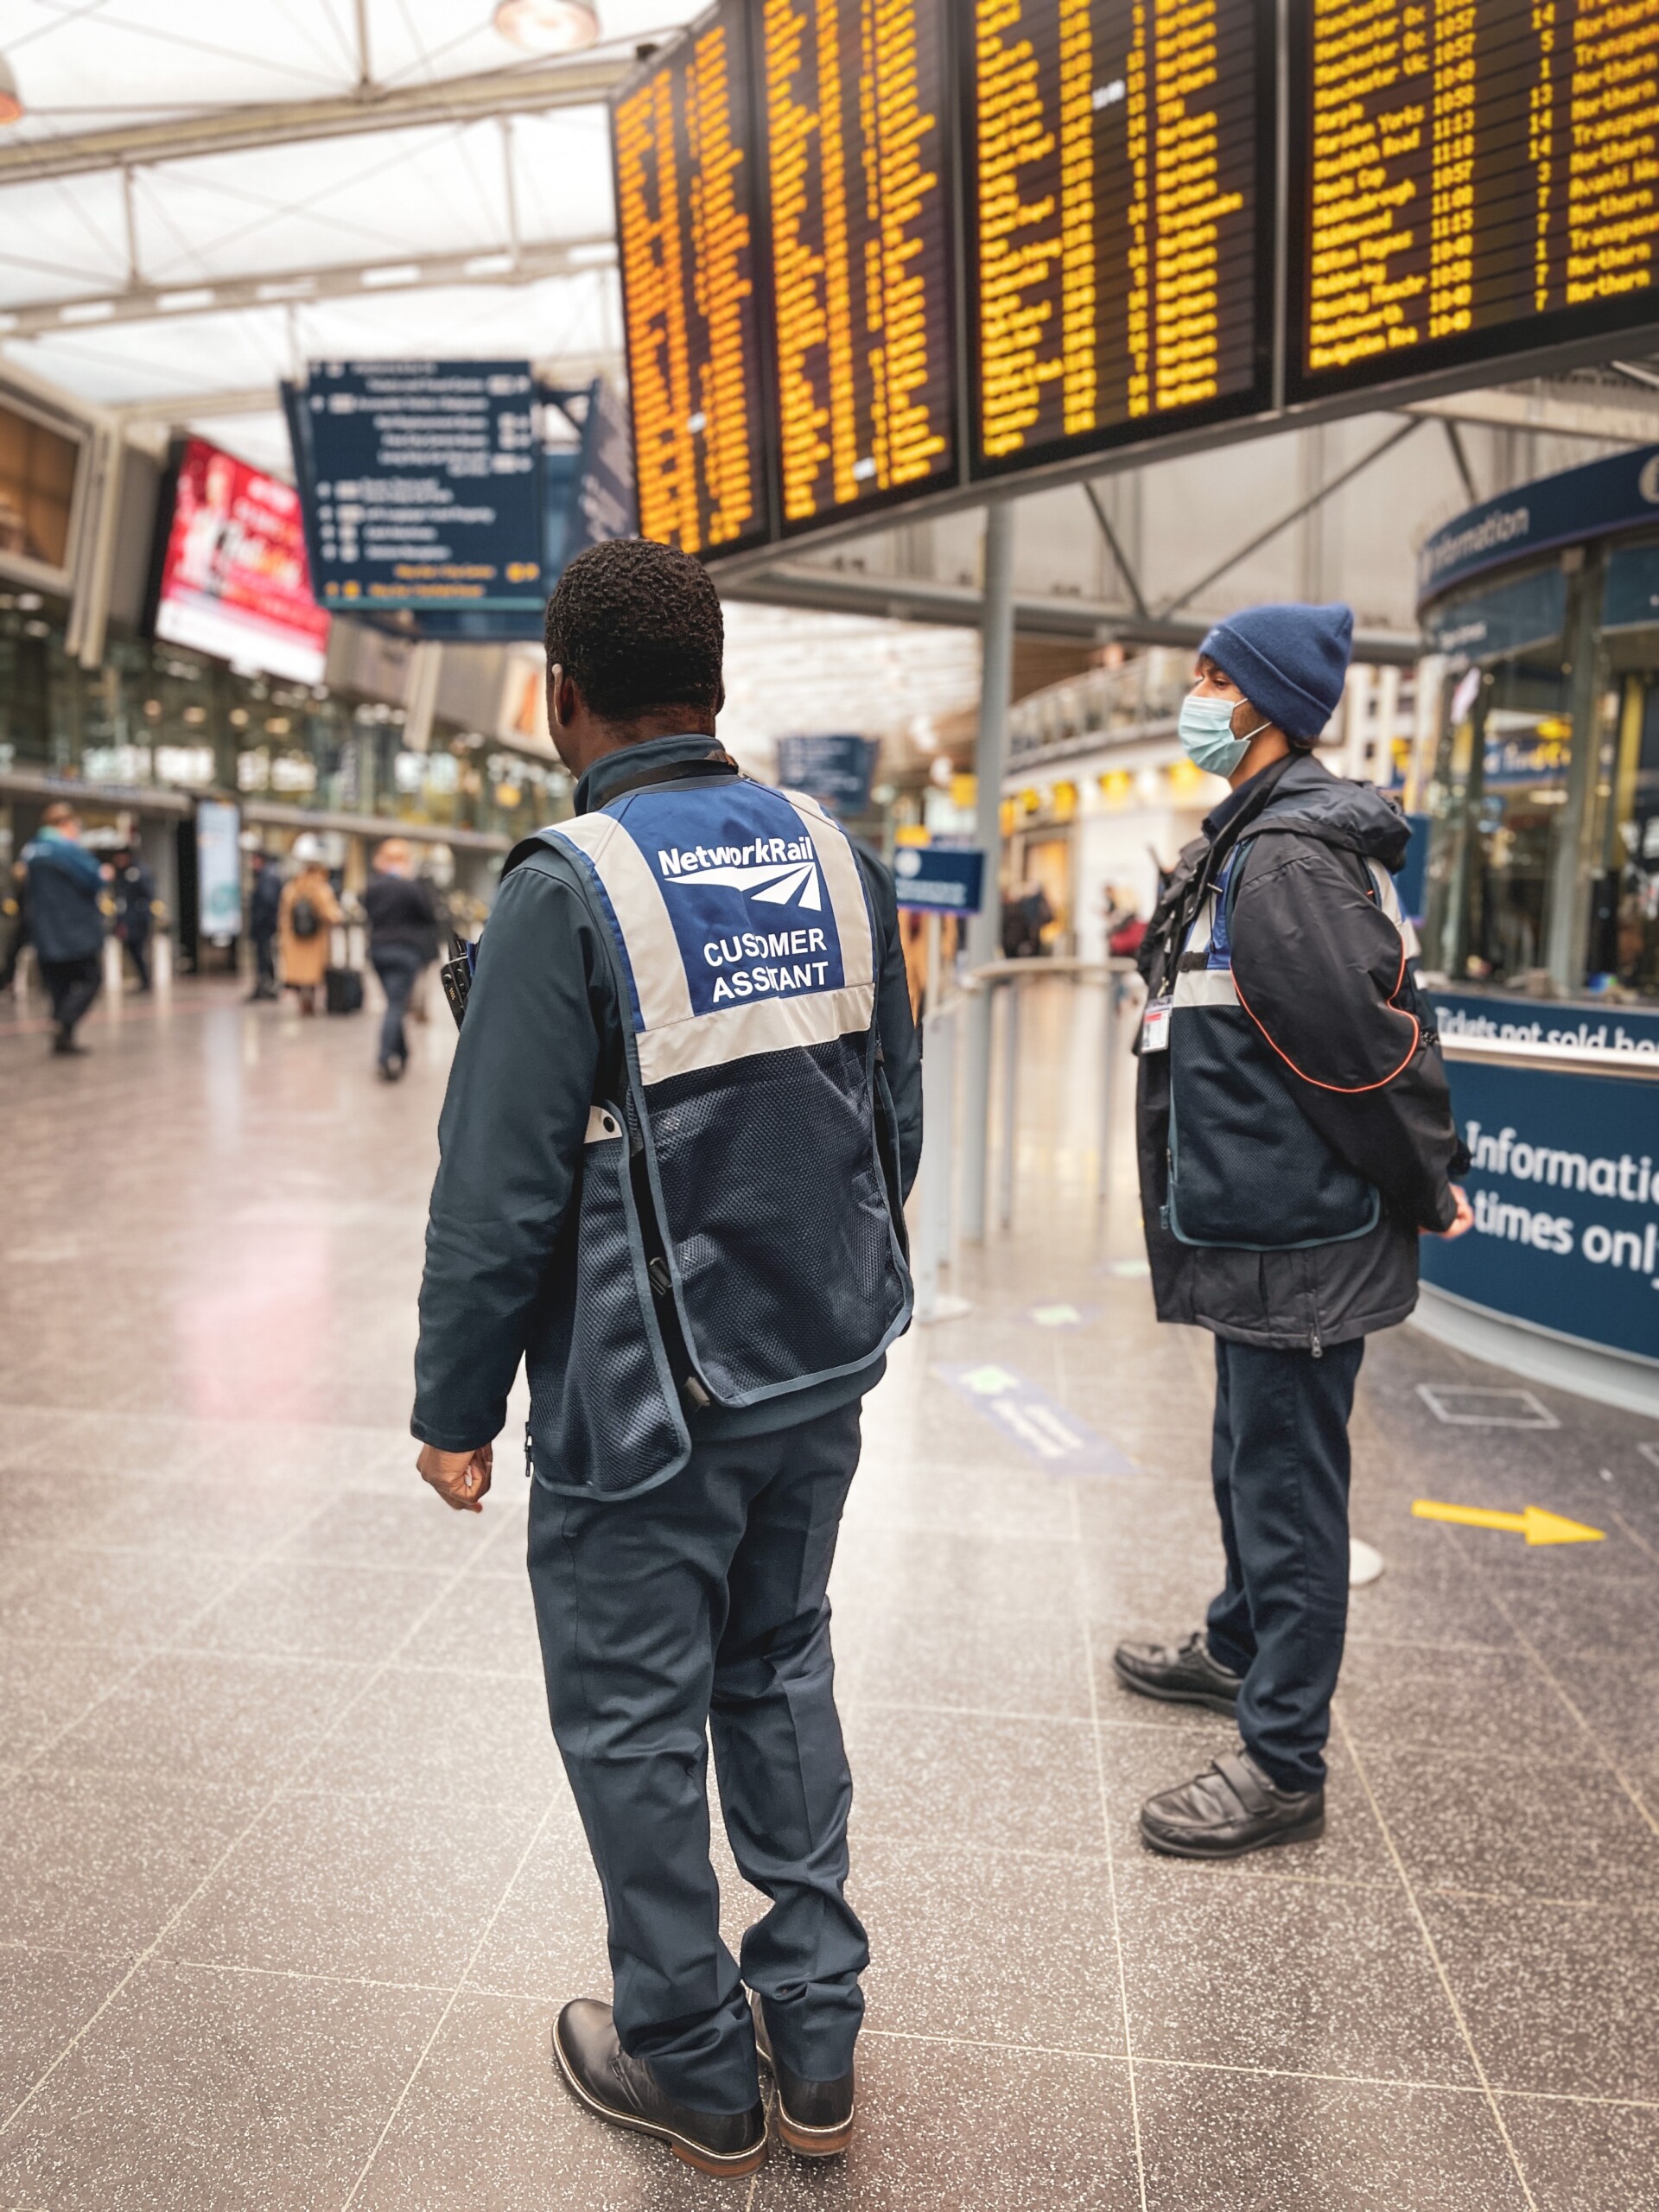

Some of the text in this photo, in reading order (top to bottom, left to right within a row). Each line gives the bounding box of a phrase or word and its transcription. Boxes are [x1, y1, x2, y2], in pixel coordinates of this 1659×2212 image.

[1531, 84, 1553, 108] 13
[1529, 110, 1552, 134] 14
[1529, 136, 1551, 160] 14
[702, 927, 828, 968] CUSOMER
[1499, 1021, 1543, 1043] not
[1546, 1022, 1608, 1049] sold
[1472, 1190, 1574, 1254] times
